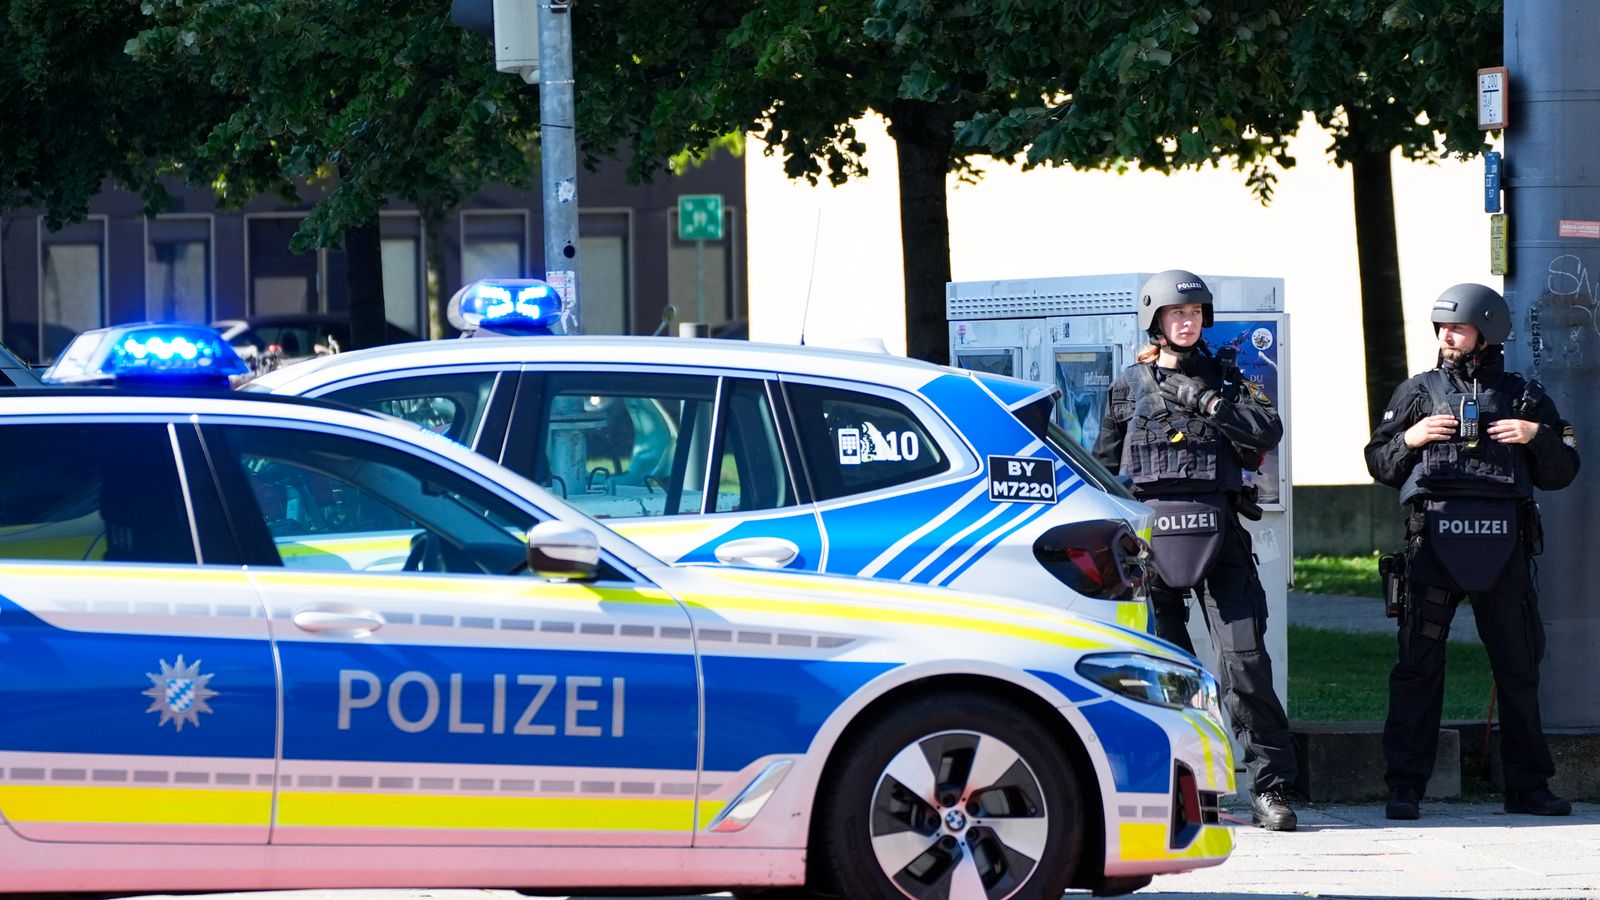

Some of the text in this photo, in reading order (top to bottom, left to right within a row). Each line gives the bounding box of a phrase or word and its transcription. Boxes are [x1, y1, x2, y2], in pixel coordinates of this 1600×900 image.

[874, 431, 919, 461] 10
[1008, 461, 1035, 476] BY
[993, 481, 1053, 498] M7220
[1154, 513, 1215, 530] OLIZEI
[1439, 520, 1508, 534] POLIZEI
[338, 669, 625, 737] POLIZEI
